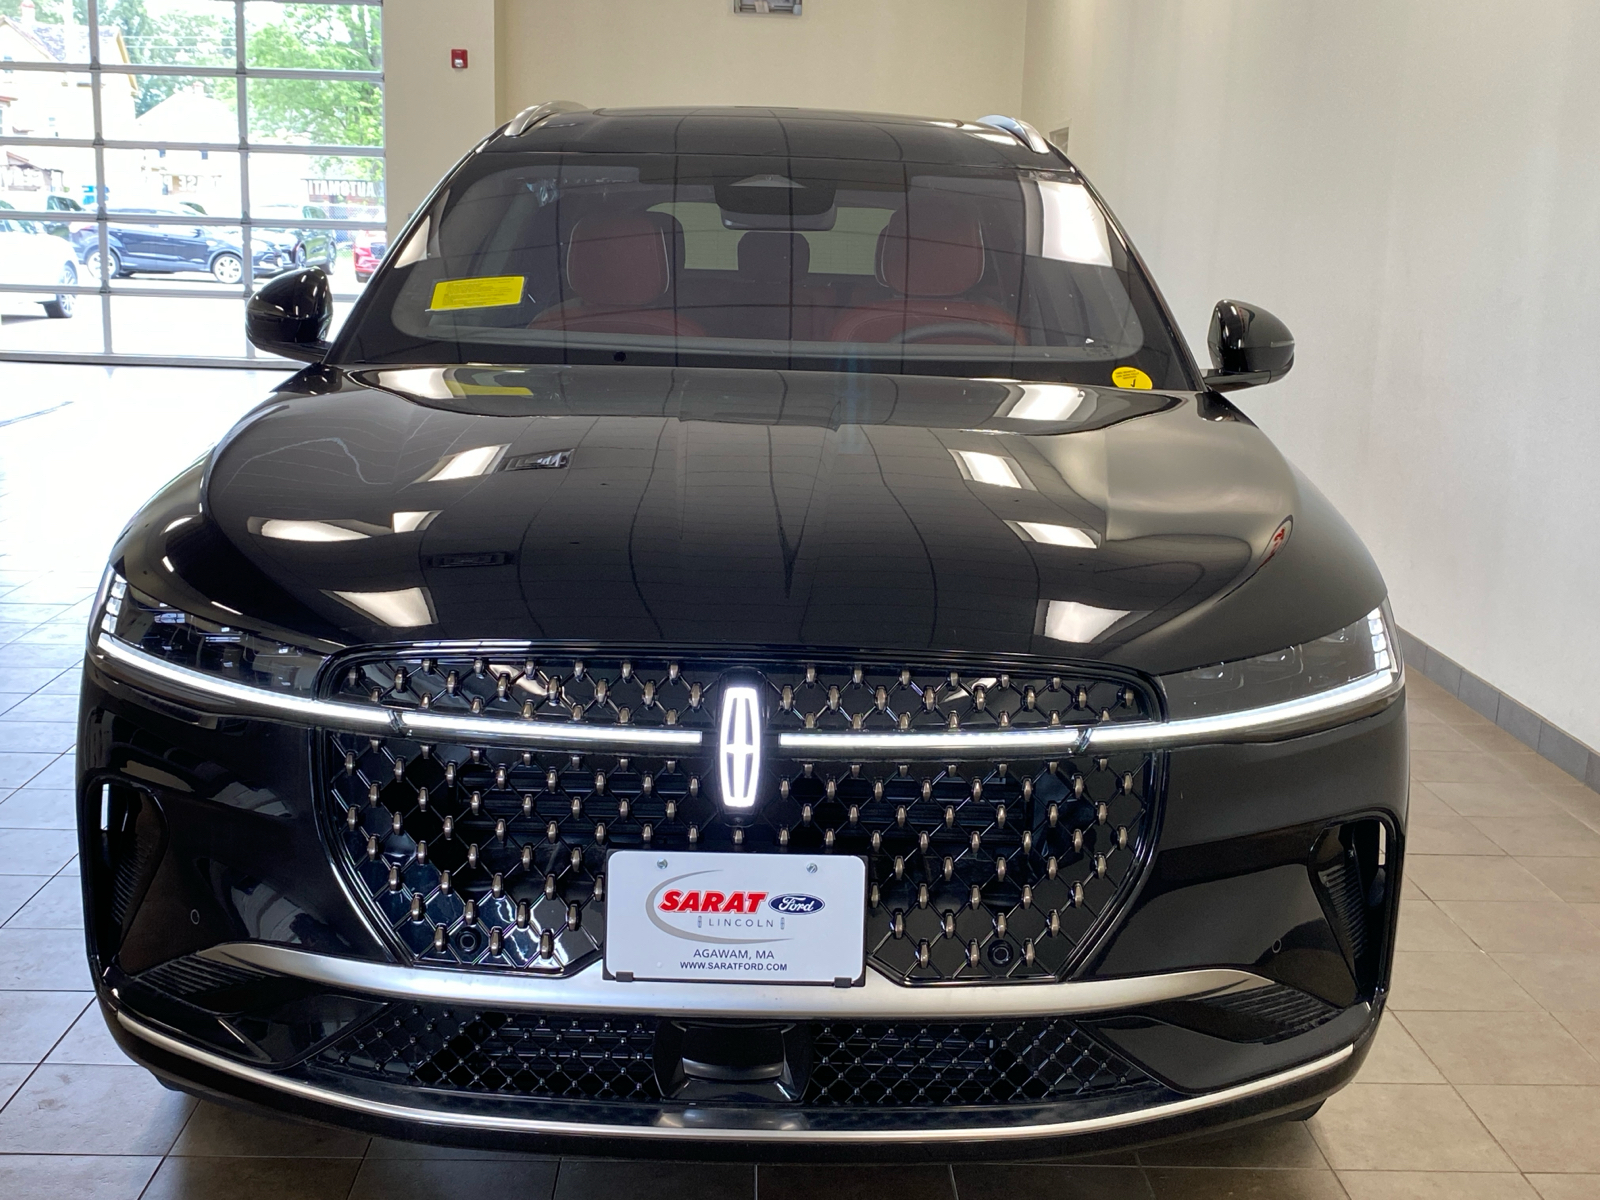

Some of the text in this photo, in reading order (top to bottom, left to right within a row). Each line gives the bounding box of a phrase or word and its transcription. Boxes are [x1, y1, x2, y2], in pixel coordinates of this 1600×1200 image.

[658, 889, 815, 914] SARAT Ford
[708, 918, 774, 928] LINCOLN
[693, 948, 775, 960] AGAWAM, MA
[680, 961, 788, 971] WWW.SARATFORD.COM
